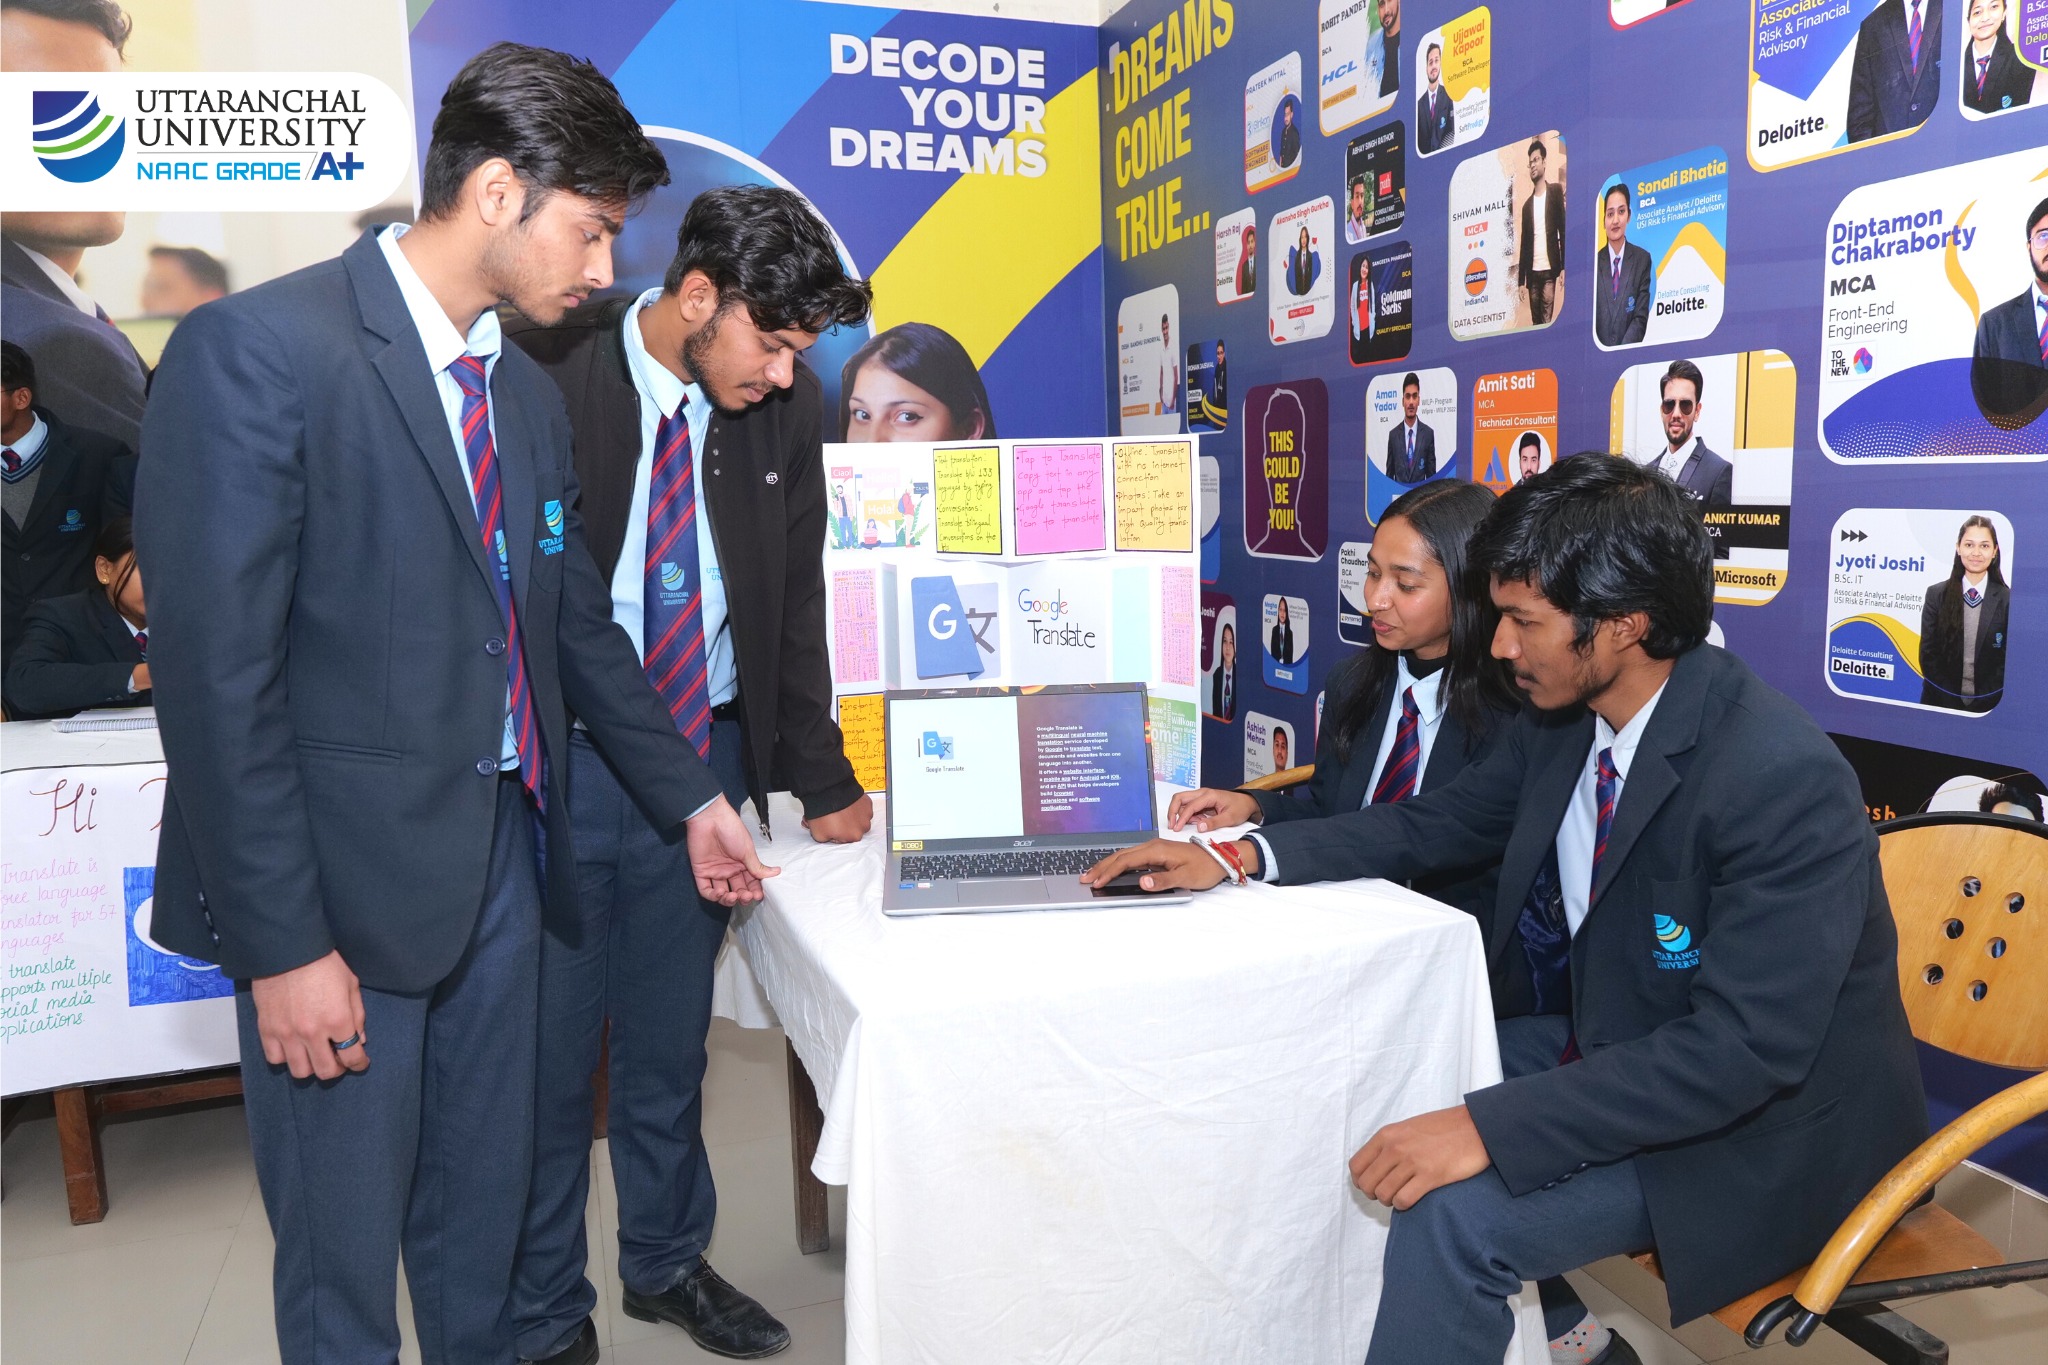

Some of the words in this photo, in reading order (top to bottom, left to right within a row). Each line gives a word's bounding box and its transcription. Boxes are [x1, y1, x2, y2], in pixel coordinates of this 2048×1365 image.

[1321, 15, 1340, 33] ROHIT
[1341, 0, 1367, 21] PANDEY
[1759, 26, 1782, 45] Risk
[1785, 22, 1793, 36] &
[1796, 2, 1850, 32] Financial
[1453, 19, 1485, 45] Ujjawal
[2027, 23, 2039, 33] USI
[1322, 46, 1332, 56] BCA
[1453, 35, 1484, 57] Kapoor
[1758, 34, 1808, 60] Advisory
[829, 33, 1045, 89] DECODE
[1113, 0, 1234, 114] DREAMS
[1462, 58, 1473, 67] BCA
[1322, 60, 1357, 86] HCL
[1447, 69, 1467, 83] Software
[1467, 59, 1490, 75] Developer
[1246, 79, 1267, 95] PRATEEK
[1268, 68, 1286, 85] MITTAL
[899, 86, 1045, 134] YOUR
[1115, 87, 1191, 188] COME
[1758, 115, 1829, 148] Deloitte.
[829, 126, 1047, 178] DREAMS
[1365, 138, 1377, 151] SINGH
[1637, 173, 1677, 197] Sonali
[1680, 160, 1727, 185] Bhatia
[1453, 206, 1482, 221] SHIVAM
[1484, 200, 1506, 214] MALL
[1637, 206, 1665, 221] Associate
[1666, 201, 1690, 215] Analyst
[1695, 193, 1722, 206] Deloitte
[1639, 196, 1656, 208] BCA
[1116, 176, 1210, 262] TRUE...
[1296, 205, 1311, 219] Singh
[1637, 220, 1647, 230] USI
[1647, 216, 1661, 227] Risk
[1661, 215, 1666, 224] &
[1667, 207, 1696, 222] Financial
[1697, 201, 1726, 216] Advisory
[1216, 227, 1231, 240] Harsh
[1232, 222, 1241, 236] Raj
[1468, 225, 1484, 235] MCA
[1832, 208, 1943, 246] Diptamon
[1831, 224, 1976, 266] Chakraborty
[1658, 288, 1679, 299] Deloitte
[1680, 284, 1710, 297] Consulting
[1830, 274, 1876, 296] MCA
[1381, 288, 1412, 306] Goldman
[1465, 295, 1488, 307] IndianOil
[1656, 296, 1708, 316] Deloitte.
[1381, 301, 1402, 316] Sachs
[1829, 301, 1894, 322] Front-End
[1454, 316, 1471, 328] DATA
[1473, 311, 1506, 326] SCIENTIST
[1828, 318, 1908, 340] Engineering
[1831, 358, 1846, 368] THE
[1832, 350, 1843, 360] TO
[1831, 366, 1850, 377] NEW
[1478, 375, 1508, 393] Amit
[1510, 371, 1535, 390] Sati
[1375, 389, 1398, 400] Aman
[1374, 401, 1398, 412] Yadav
[1478, 400, 1495, 409] MCA
[1478, 417, 1513, 428] Technical
[1514, 415, 1556, 426] Consultant
[1269, 429, 1294, 452] THIS
[1018, 450, 1035, 470] Tap
[1042, 450, 1052, 465] to
[1152, 459, 1187, 473] internet
[1264, 456, 1300, 478] COULD
[833, 469, 851, 477] Ciao!
[978, 467, 992, 478] 133
[1077, 470, 1100, 485] any
[1038, 483, 1053, 494] and
[1076, 482, 1092, 494] the
[1153, 489, 1170, 499] Take
[1274, 482, 1289, 504] BE
[868, 504, 895, 516] Hola!
[1019, 499, 1044, 518] Google
[1051, 495, 1096, 514] translate
[1150, 503, 1173, 518] photos
[1043, 516, 1055, 531] to
[1119, 517, 1134, 534] high
[1268, 507, 1295, 530] YOU!
[1703, 513, 1736, 524] ANKIT
[1738, 514, 1780, 525] KUMAR
[1341, 548, 1356, 557] Pakhi
[1836, 554, 1876, 572] Jyoti
[1879, 556, 1925, 572] Joshi
[1342, 569, 1352, 577] BCA
[1714, 570, 1776, 586] Microsoft
[1834, 573, 1853, 584] B.Sc.
[1855, 575, 1863, 584] IT
[1017, 588, 1069, 621] Google
[1834, 589, 1863, 598] Associate
[1864, 591, 1888, 600] Analyst
[1896, 593, 1922, 602] Deloitte
[1845, 597, 1858, 605] Risk
[1865, 598, 1893, 608] Financial
[1894, 602, 1923, 612] Advisory
[928, 603, 957, 640] G
[965, 608, 997, 654] 文
[1027, 619, 1096, 649] Translate
[1832, 645, 1858, 656] Deloitte
[1858, 648, 1894, 661] Consulting
[1833, 659, 1890, 679] Deloitte.
[843, 697, 875, 712] Instant
[1247, 721, 1266, 735] Ashish
[927, 738, 936, 748] G
[1247, 731, 1265, 746] Mehra
[1248, 748, 1256, 756] MCA
[943, 765, 964, 773] Translate
[30, 779, 97, 836] Hi
[1013, 839, 1034, 847] acer
[1, 859, 80, 884] Translate
[88, 857, 98, 872] is
[38, 883, 108, 908] language
[72, 907, 93, 927] for
[98, 904, 117, 920] 57
[9, 956, 76, 978] translate
[51, 970, 112, 991] multiple
[47, 993, 95, 1012] media
